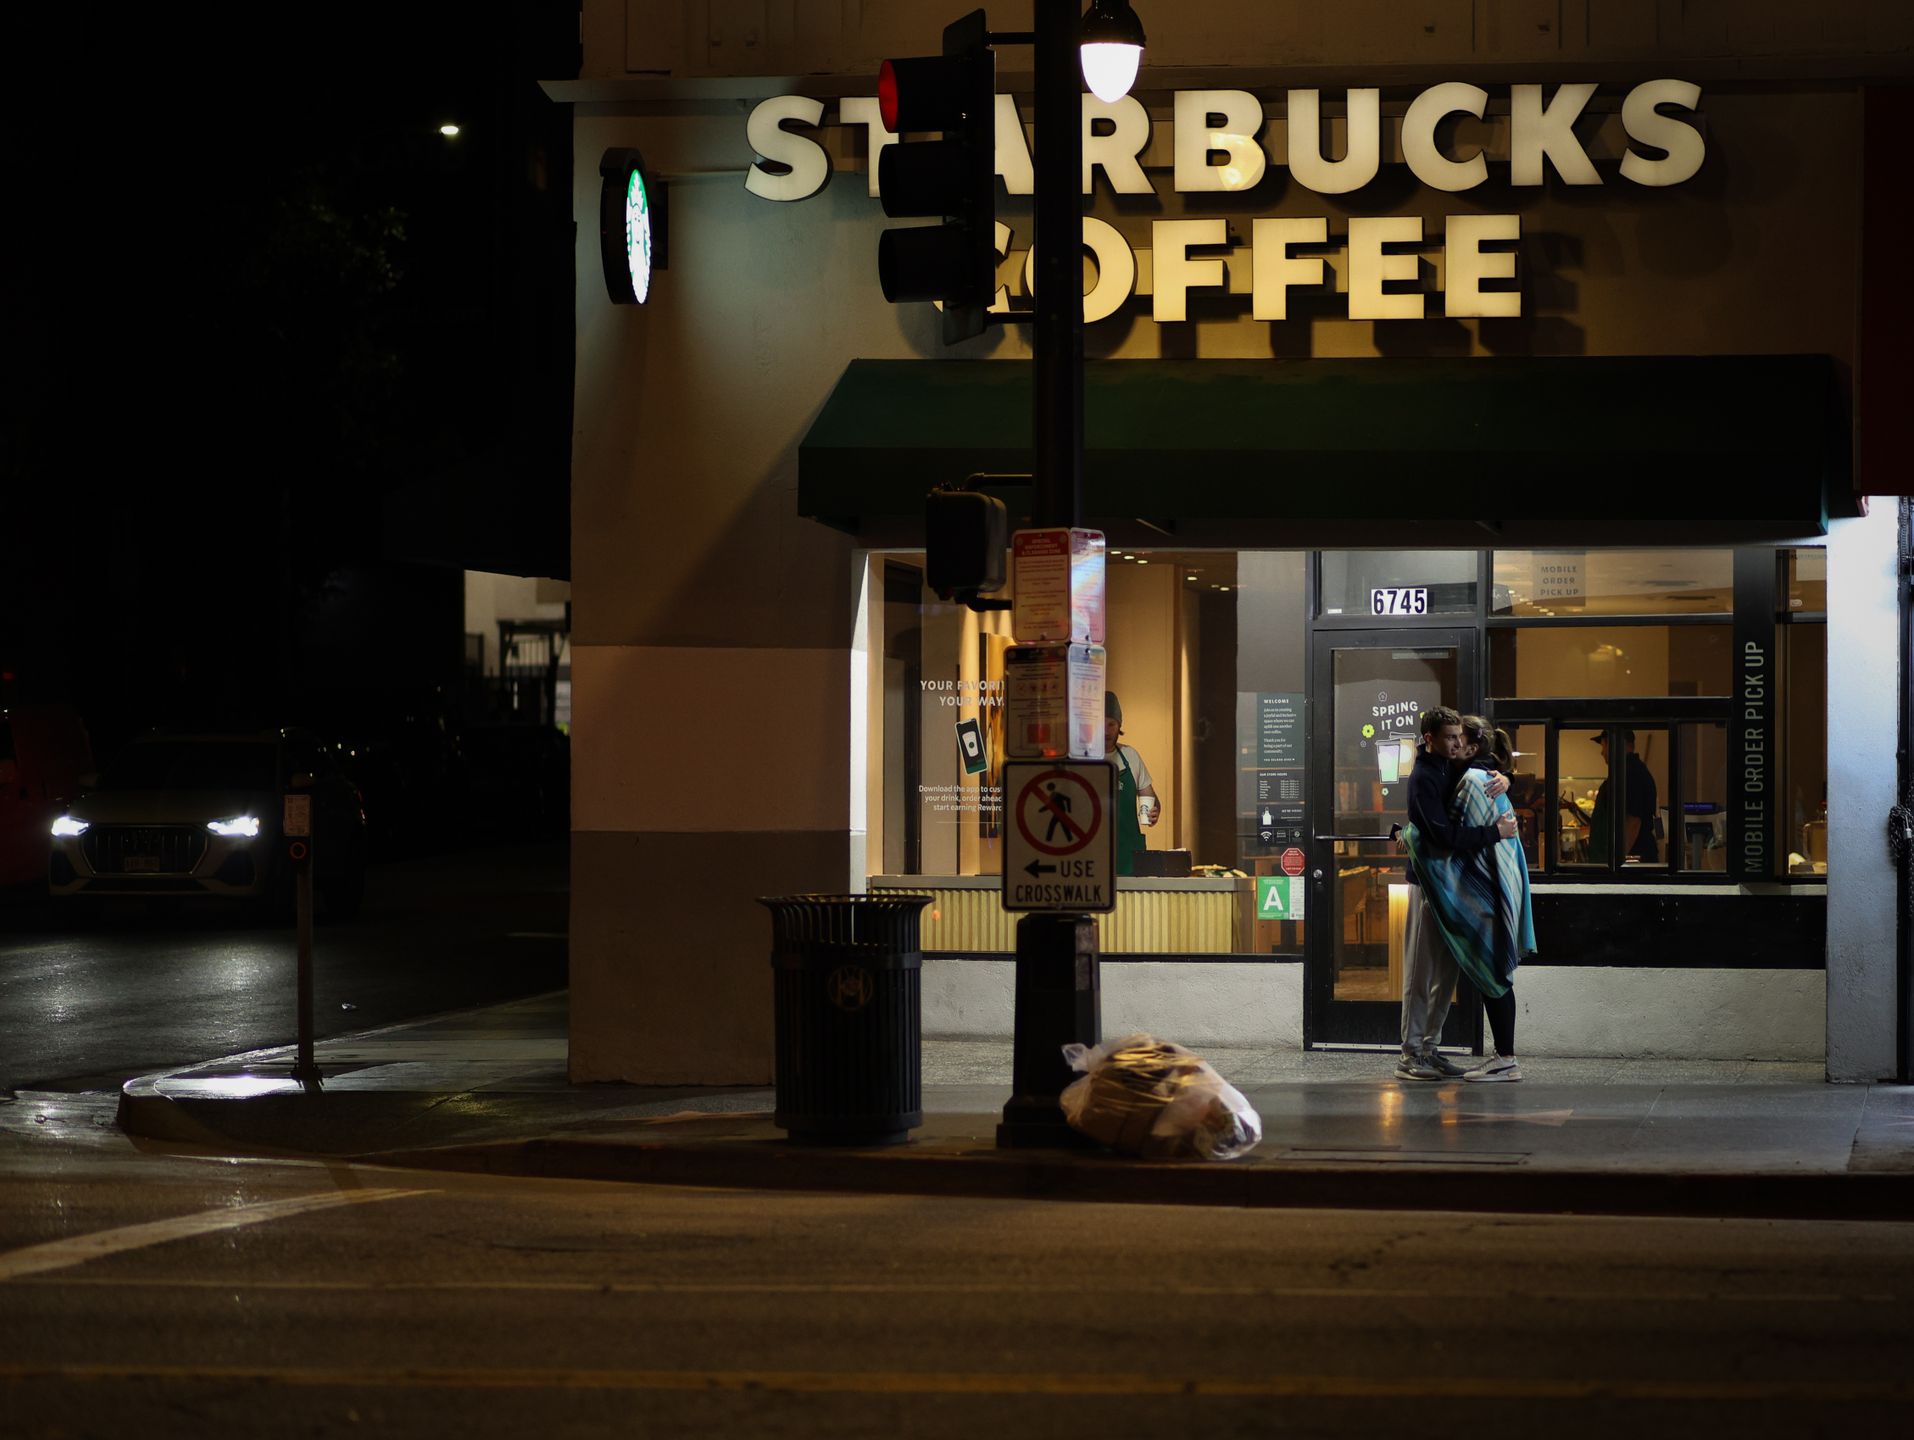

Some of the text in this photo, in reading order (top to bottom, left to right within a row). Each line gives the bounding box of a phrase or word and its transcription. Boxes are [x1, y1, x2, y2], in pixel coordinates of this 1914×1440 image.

[1373, 589, 1425, 614] 6745
[920, 680, 953, 690] YOUR
[939, 696, 973, 706] YOUR
[1372, 701, 1418, 717] SPRING
[1381, 715, 1414, 730] IT ON
[1744, 641, 1764, 872] MOBILE ORDER PICK UP
[919, 785, 952, 793] Download
[953, 785, 965, 793] the
[940, 794, 961, 803] drink,
[961, 794, 980, 802] order
[950, 804, 977, 812] earning
[1060, 860, 1095, 878] USE
[1015, 884, 1102, 903] CROSSWALK
[1263, 885, 1284, 911] A
